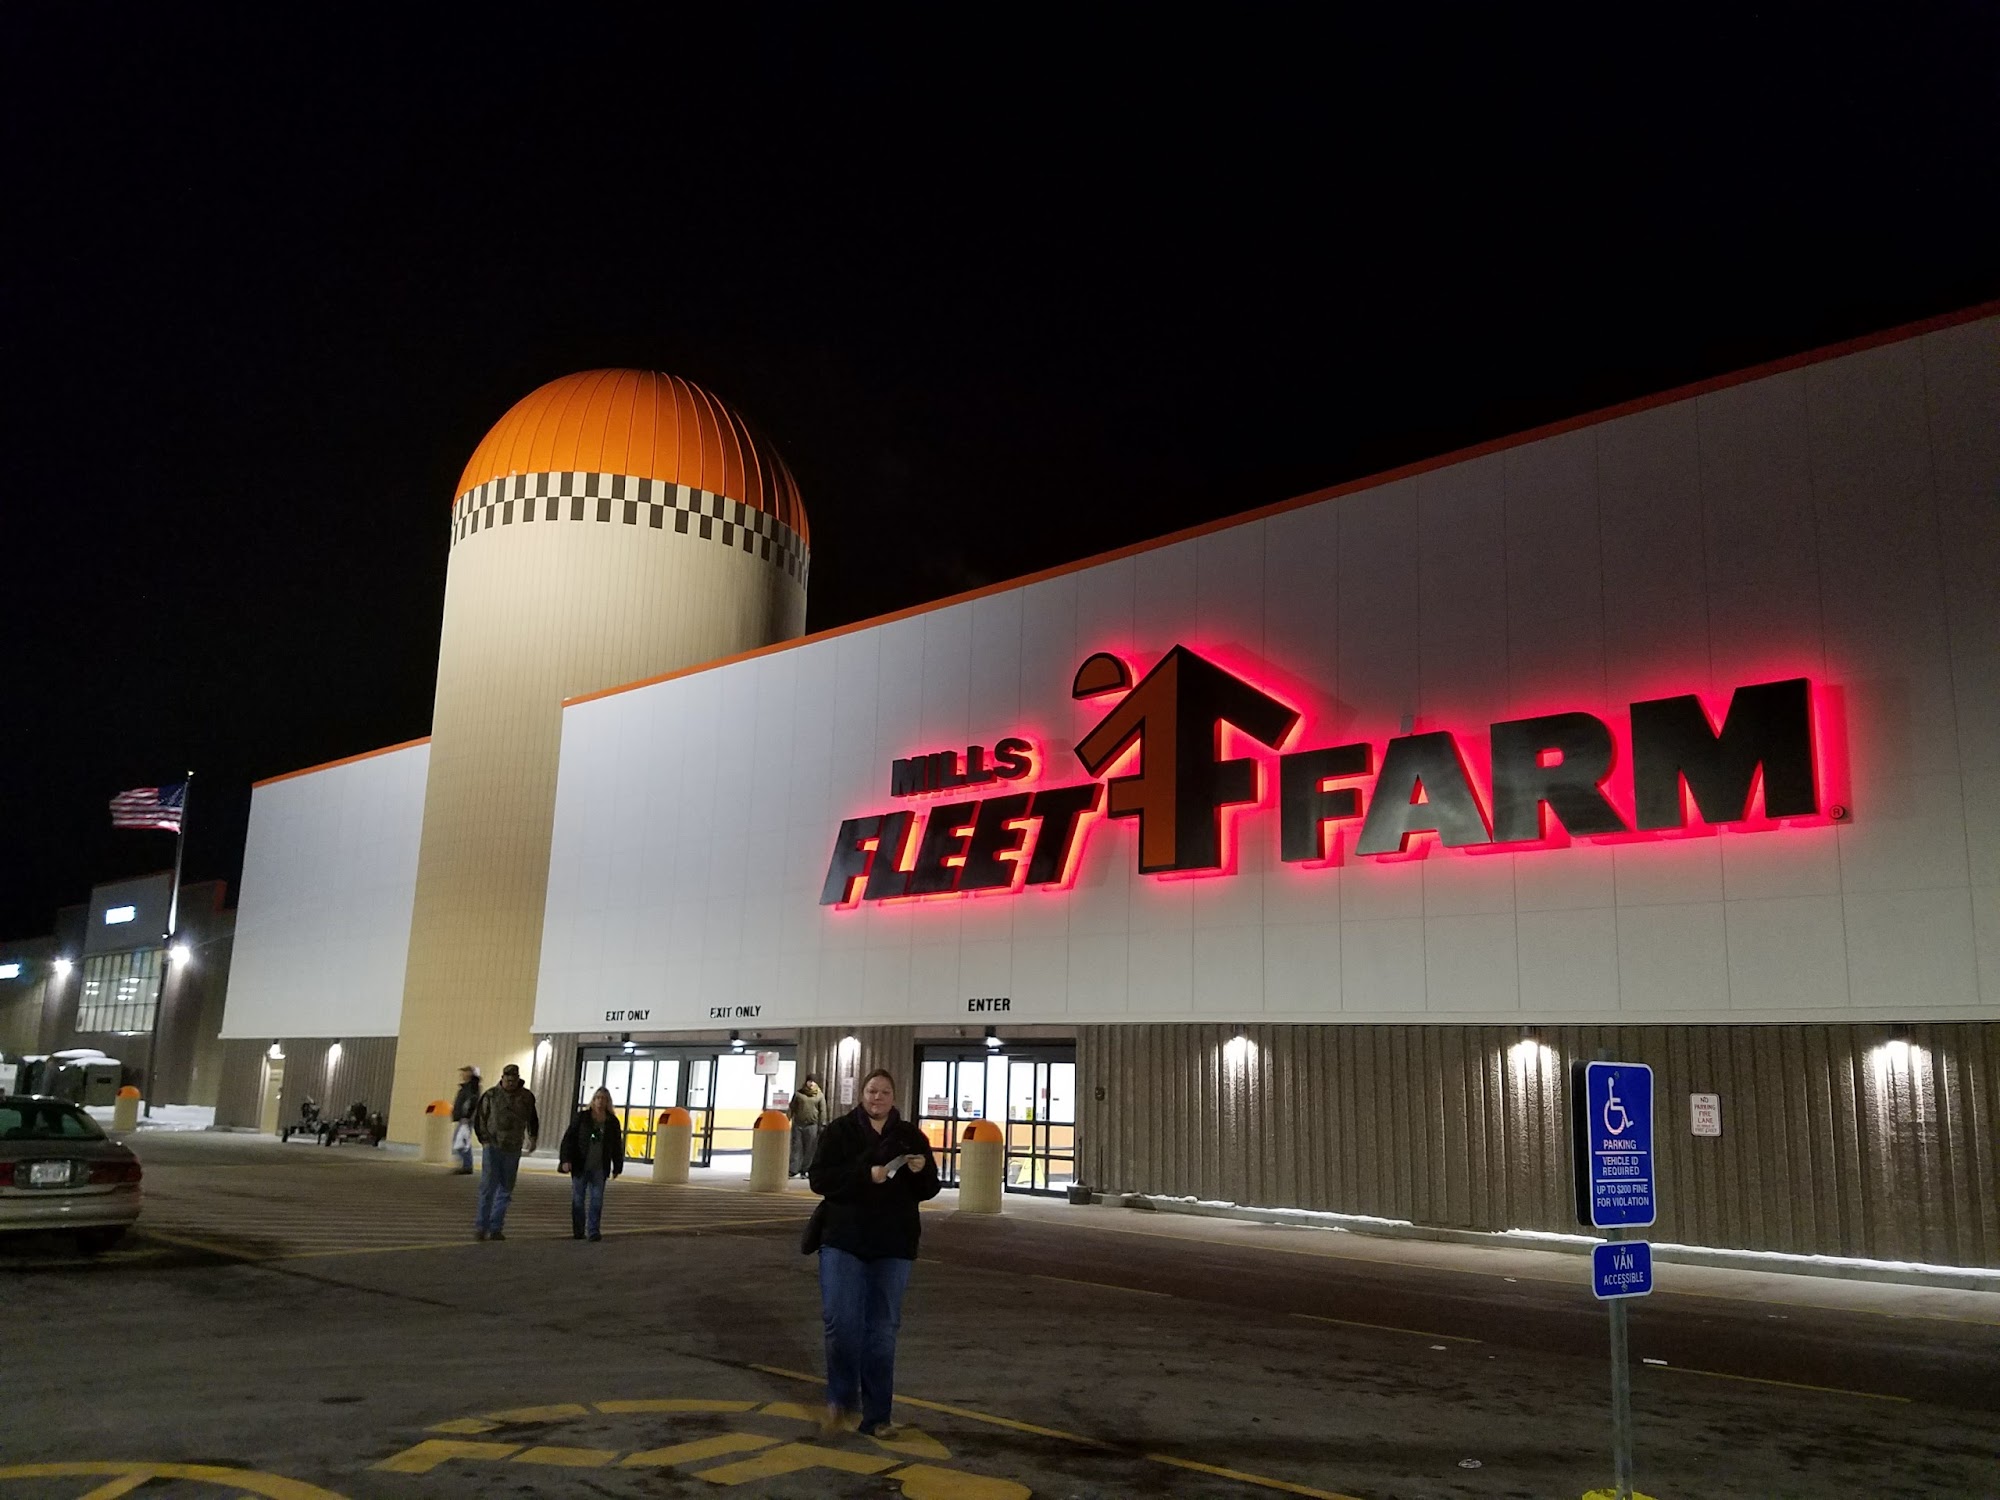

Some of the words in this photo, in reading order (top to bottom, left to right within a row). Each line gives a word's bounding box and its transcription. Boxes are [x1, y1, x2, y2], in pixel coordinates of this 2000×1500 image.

[890, 737, 1033, 797] MILLS
[819, 783, 1104, 905] FLEET
[1280, 677, 1819, 863] FARM
[968, 998, 1010, 1011] ENTER
[606, 1010, 625, 1021] EXIT
[628, 1010, 650, 1020] ONLY
[710, 1007, 732, 1018] EXIT
[735, 1006, 761, 1018] ONLY
[1603, 1139, 1637, 1150] PARKING
[1602, 1156, 1630, 1166] VEHICLE
[1631, 1156, 1639, 1165] ID
[1602, 1166, 1640, 1176] REQUIRED
[1596, 1185, 1606, 1194] UP
[1607, 1185, 1616, 1194] TO
[1617, 1184, 1631, 1194] $200
[1632, 1184, 1648, 1193] FINE
[1597, 1197, 1611, 1207] FOR
[1613, 1196, 1649, 1206] VIOLATION
[1613, 1253, 1634, 1270] VAN
[1603, 1272, 1644, 1286] ACCESSIBLE
